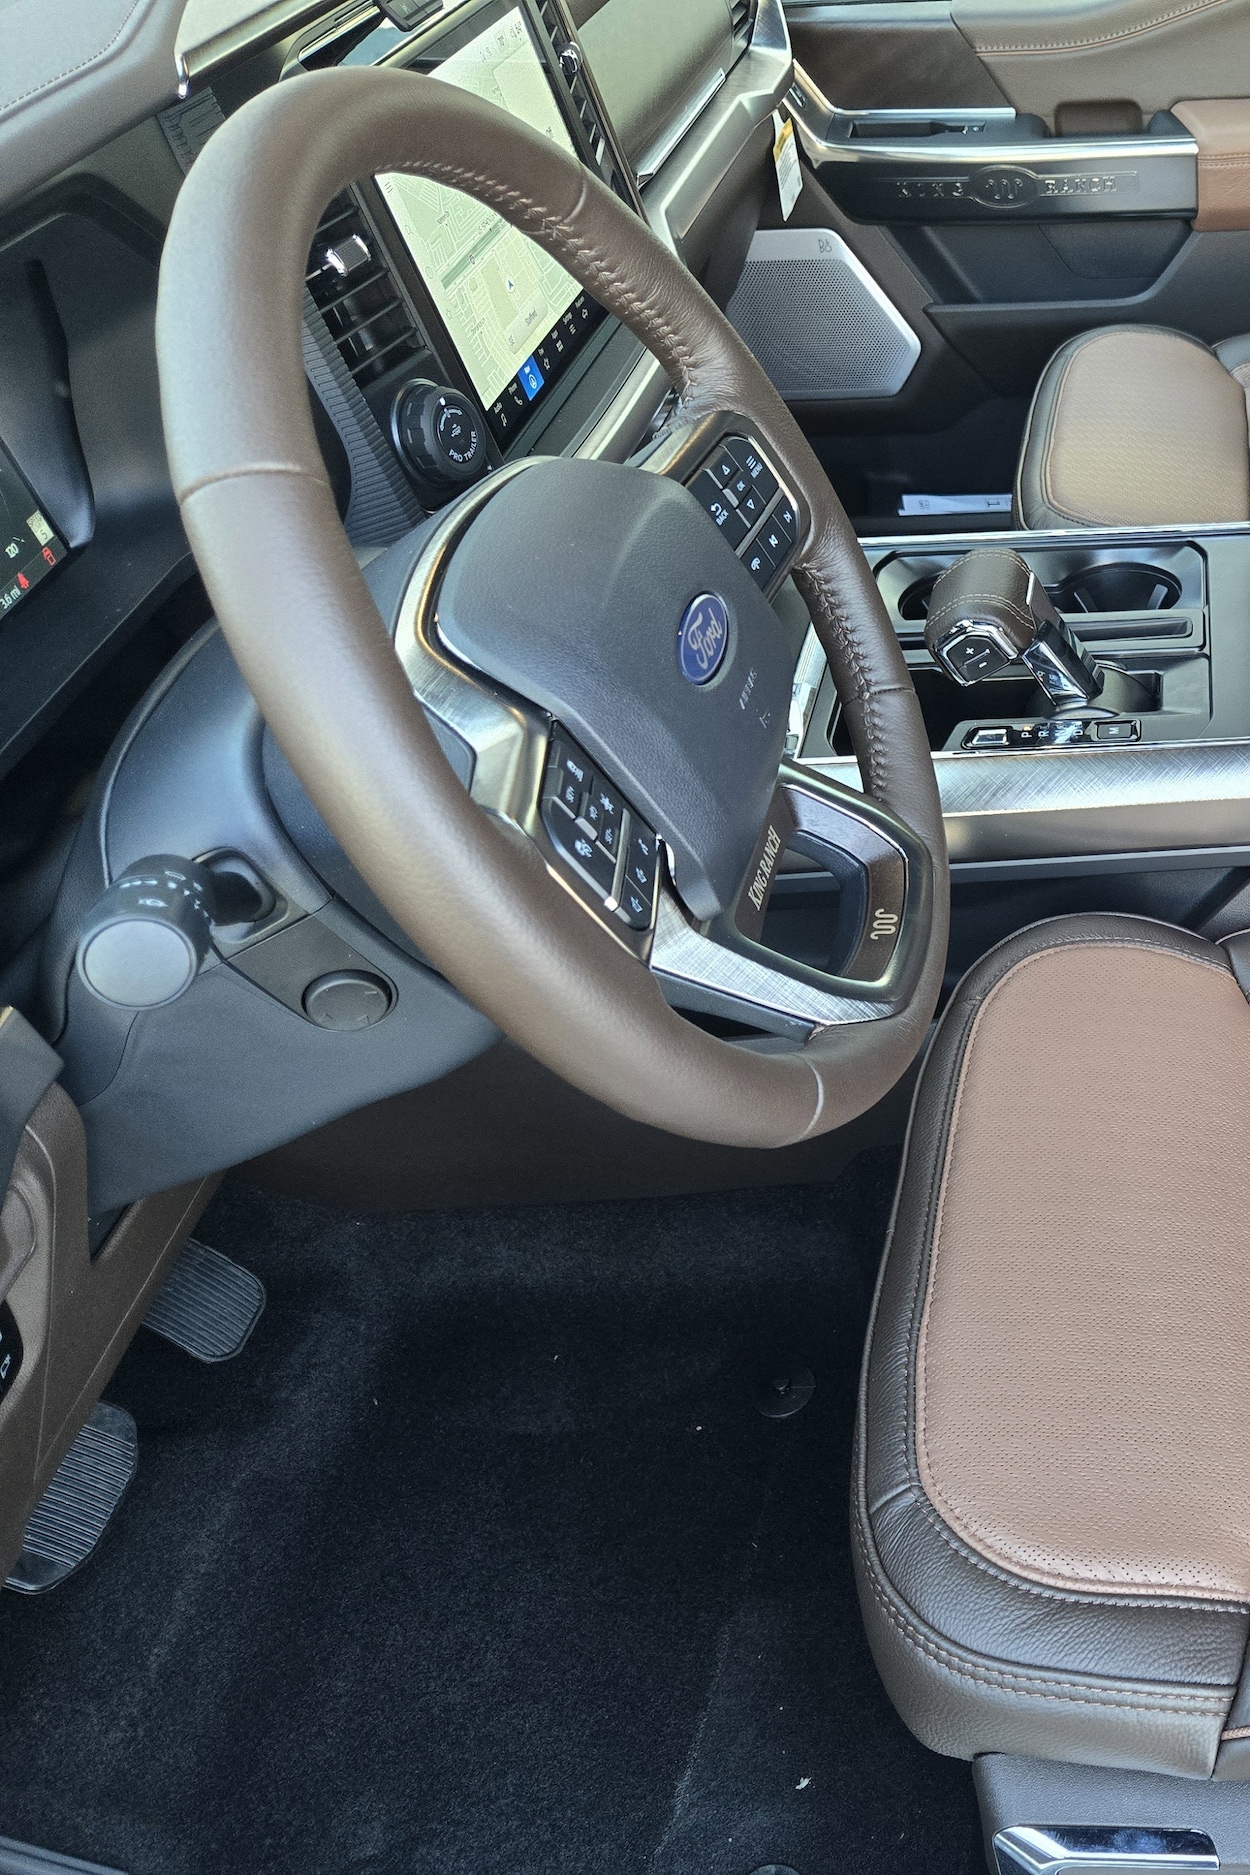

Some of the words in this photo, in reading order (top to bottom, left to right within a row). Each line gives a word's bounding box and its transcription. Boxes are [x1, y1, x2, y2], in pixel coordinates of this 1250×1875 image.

[1044, 175, 1119, 196] RANCH
[448, 448, 463, 462] PRO
[463, 430, 477, 461] TRAILER
[715, 509, 729, 526] BACK
[39, 529, 48, 540] 5
[4, 542, 19, 559] 120
[687, 607, 723, 670] Ford
[1108, 726, 1120, 735] M
[747, 867, 769, 912] KING
[759, 824, 781, 879] RANCH
